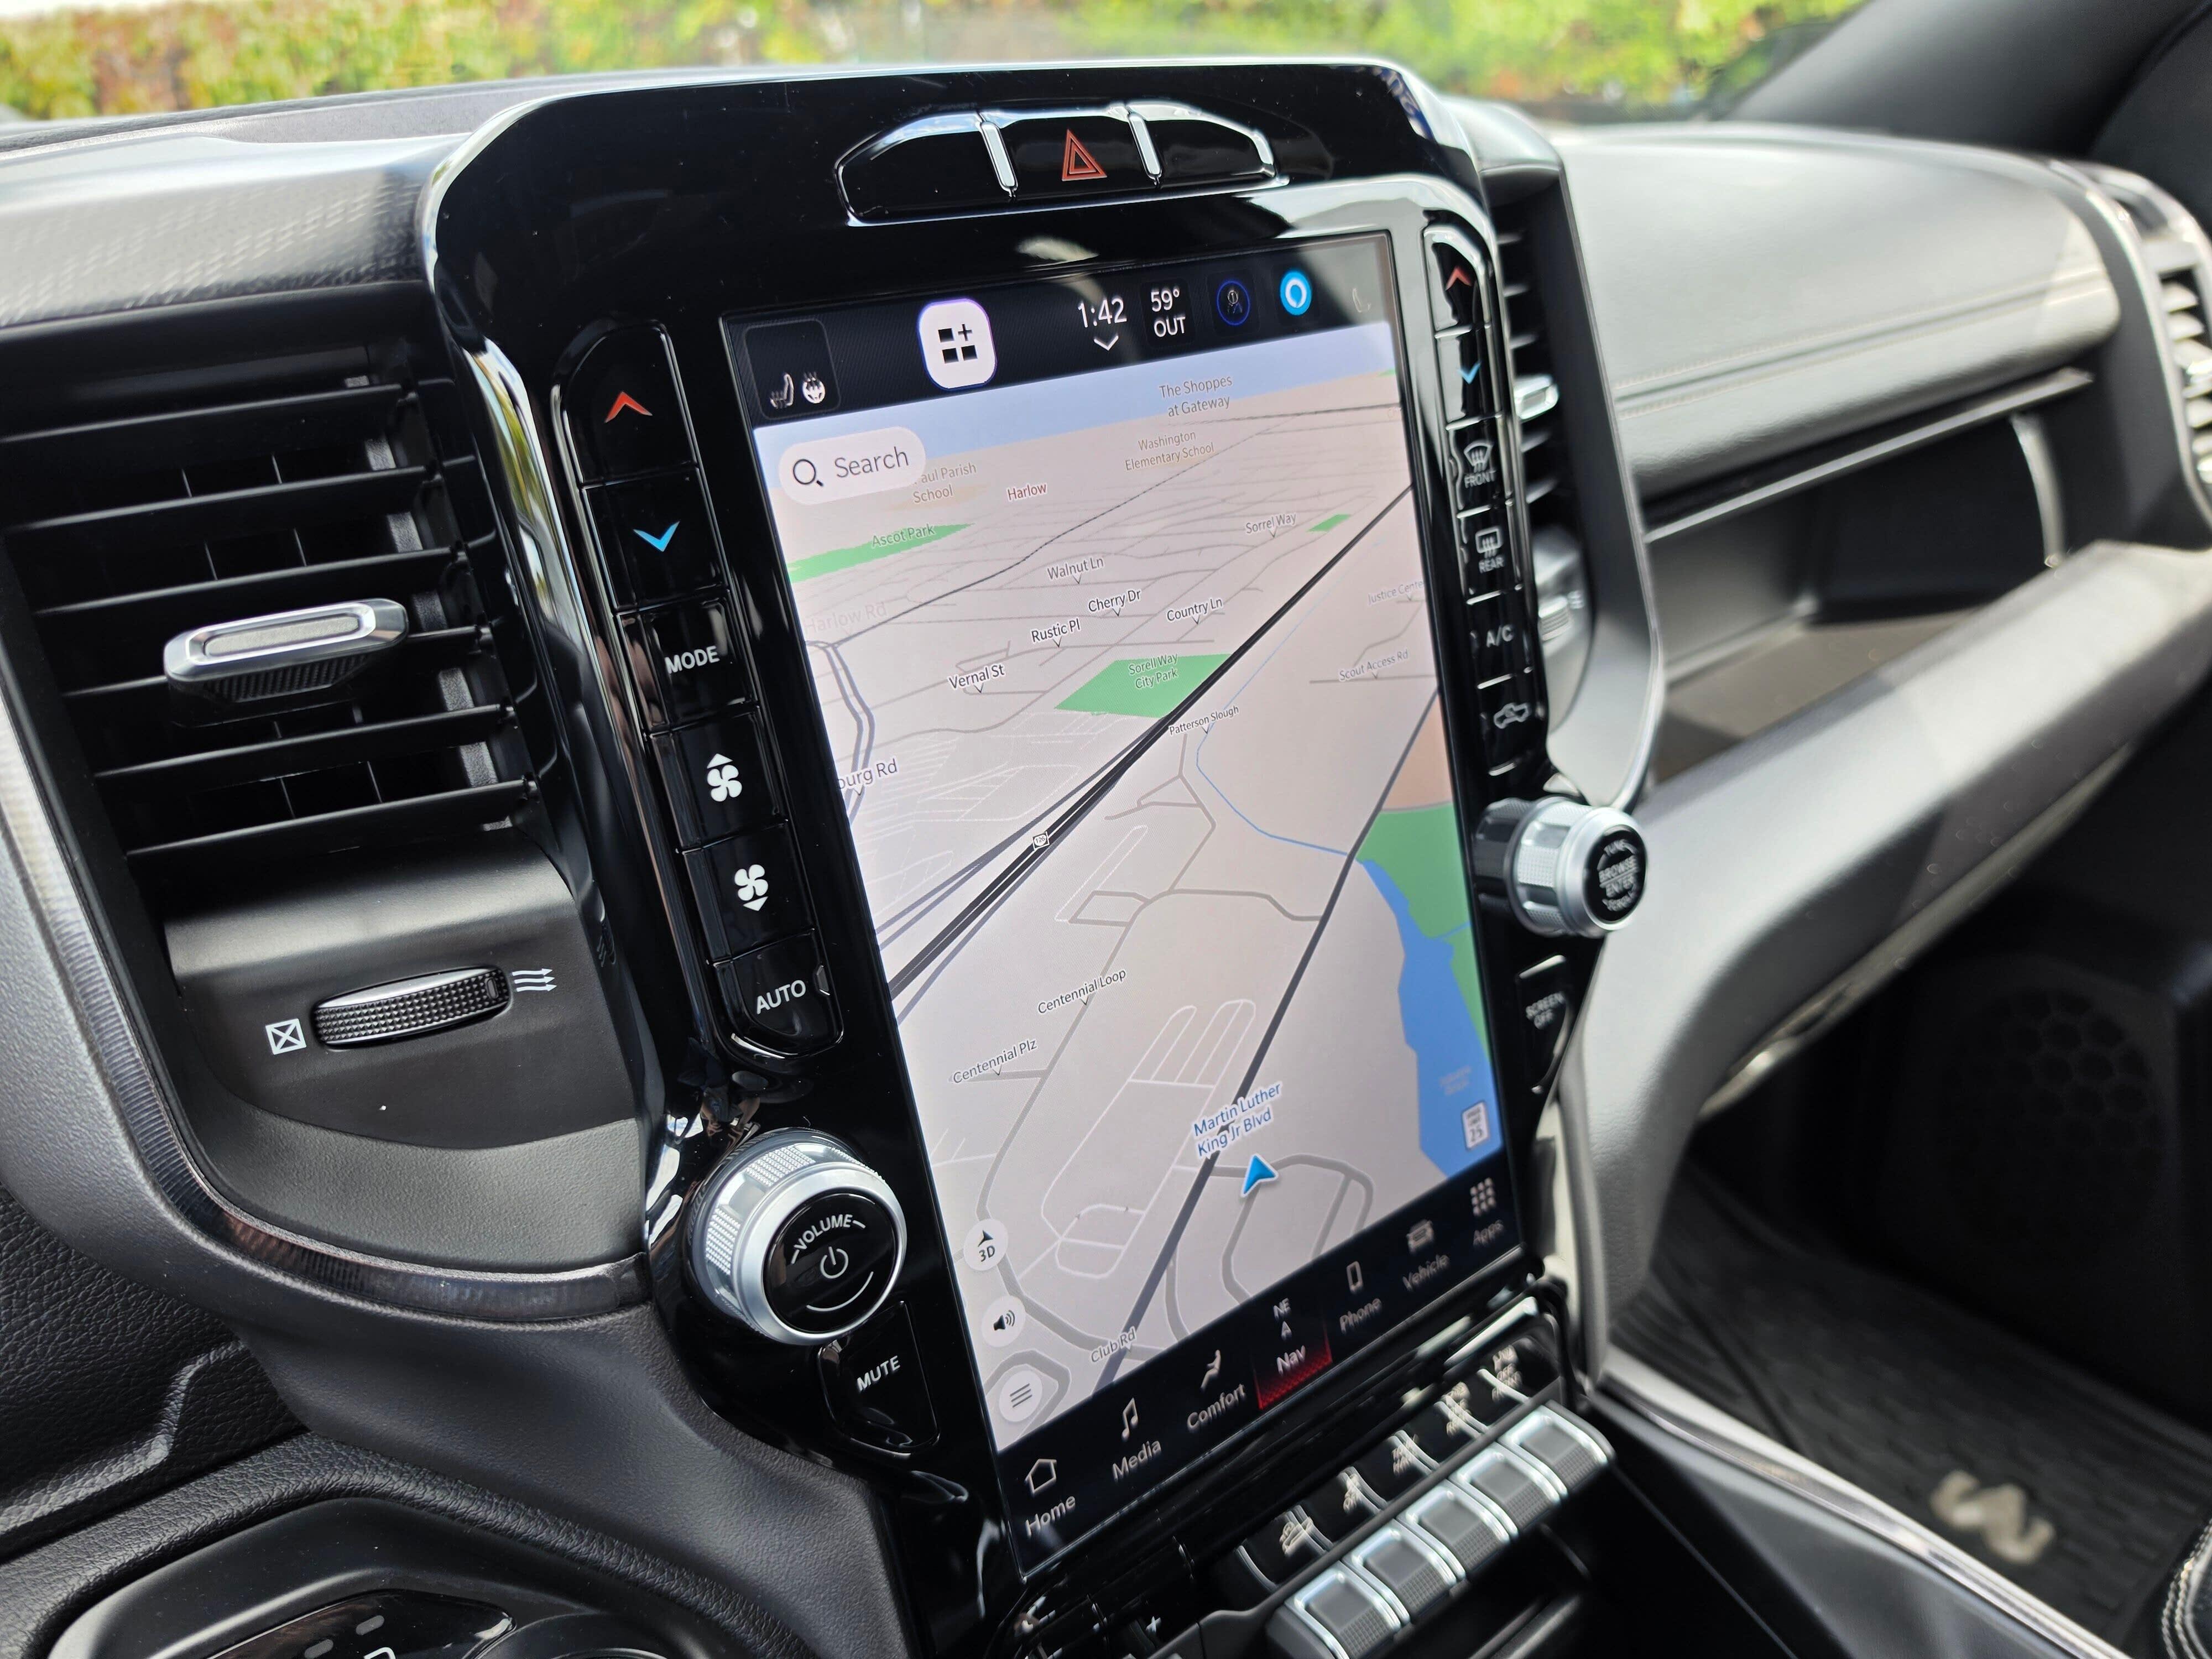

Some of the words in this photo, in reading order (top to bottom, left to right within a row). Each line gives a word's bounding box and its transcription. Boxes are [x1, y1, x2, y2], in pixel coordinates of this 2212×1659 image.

[1078, 298, 1127, 328] 1:42
[1154, 316, 1186, 338] OUT
[1159, 383, 1181, 399] The
[1183, 374, 1233, 396] Shoppes
[1167, 404, 1180, 418] at
[1181, 395, 1230, 416] Gateway
[1138, 430, 1197, 452] Washington
[834, 446, 909, 479] Search
[1125, 449, 1181, 472] Elementary
[1182, 442, 1214, 461] School
[919, 469, 938, 484] aul
[940, 462, 977, 479] Parish
[1464, 470, 1497, 489] FRONT
[913, 484, 953, 503] School
[1008, 483, 1047, 500] Harlow
[872, 528, 906, 547] Ascot
[907, 523, 935, 540] Park
[1246, 517, 1275, 534] Sorrel
[1276, 512, 1297, 527] Way
[1047, 559, 1089, 580] Walnut
[1091, 556, 1104, 570] Ln
[1478, 554, 1505, 573] REAR
[1088, 594, 1125, 612] Cherry
[1128, 589, 1141, 603] Dr
[1368, 588, 1397, 606] Justice
[1398, 580, 1424, 594] Cente
[803, 611, 862, 635] Harlow
[865, 602, 888, 620] Rd
[1167, 603, 1209, 622] Country
[1211, 597, 1223, 609] Ln
[1031, 623, 1067, 643] Rustic
[1069, 618, 1081, 634] Pl
[1485, 624, 1514, 648] A/C
[665, 646, 720, 674] MODE
[1129, 657, 1156, 675] Sorell
[1157, 653, 1178, 666] Way
[1339, 664, 1365, 681] Scout
[1366, 656, 1396, 673] Access
[1397, 649, 1408, 661] Rd
[948, 666, 990, 689] Vernal
[991, 664, 1005, 679] St
[1135, 676, 1154, 688] City
[1156, 668, 1178, 682] Park
[1168, 716, 1210, 736] Patterson
[1212, 705, 1239, 724] Slough
[877, 758, 898, 778] Rd
[755, 979, 807, 1015] AUTO
[1038, 979, 1099, 1014] Centennial
[1099, 969, 1126, 988] Loop
[952, 1047, 1018, 1084] Centennial
[1019, 1039, 1038, 1056] Plz
[1194, 1105, 1238, 1138] Martin
[1239, 1083, 1282, 1112] Luther
[1197, 1131, 1229, 1157] King
[1230, 1125, 1242, 1143] Jr
[1243, 1109, 1272, 1134] Blvd
[794, 1213, 853, 1252] VOLUME
[1472, 1219, 1505, 1248] Apps
[978, 1245, 996, 1262] 3D
[1402, 1254, 1451, 1292] Vehicle
[1273, 1297, 1292, 1321] NE
[1339, 1297, 1383, 1334] Phone
[1091, 1338, 1118, 1363] Club
[1119, 1328, 1136, 1347] Rd
[1276, 1345, 1306, 1376] Nav
[856, 1355, 901, 1394] MUTE
[1186, 1383, 1246, 1433] Comfort
[1112, 1439, 1162, 1483] Media
[1025, 1494, 1076, 1538] Home
